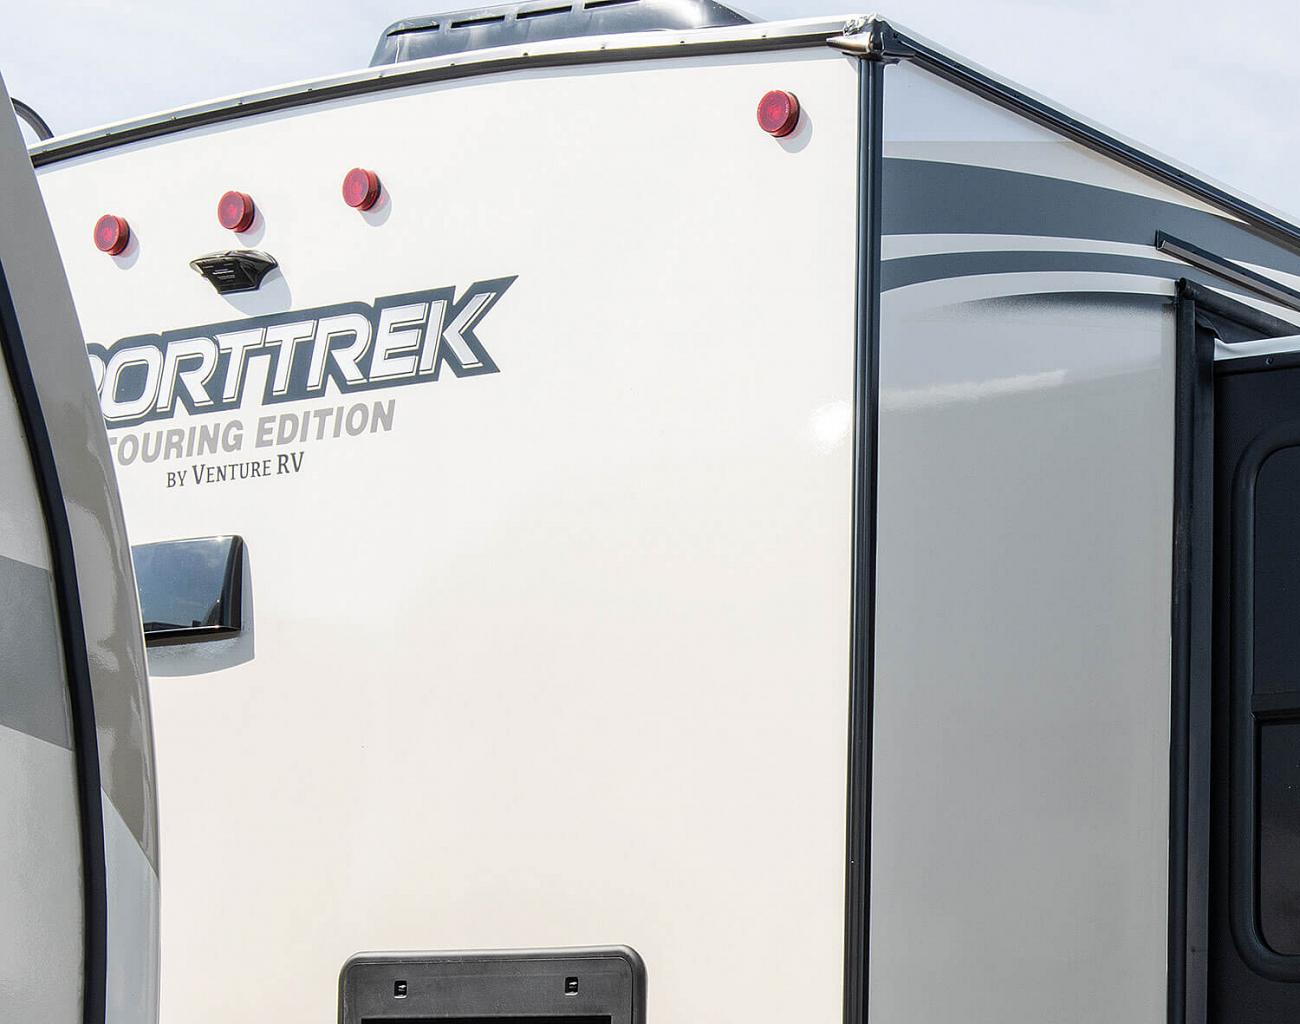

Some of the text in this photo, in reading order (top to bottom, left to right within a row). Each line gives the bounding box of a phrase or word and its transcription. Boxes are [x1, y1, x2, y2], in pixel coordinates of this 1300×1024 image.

[87, 276, 518, 429] ORTTREK
[255, 399, 396, 448] EDITION
[166, 470, 187, 488] BY
[276, 451, 304, 475] RV
